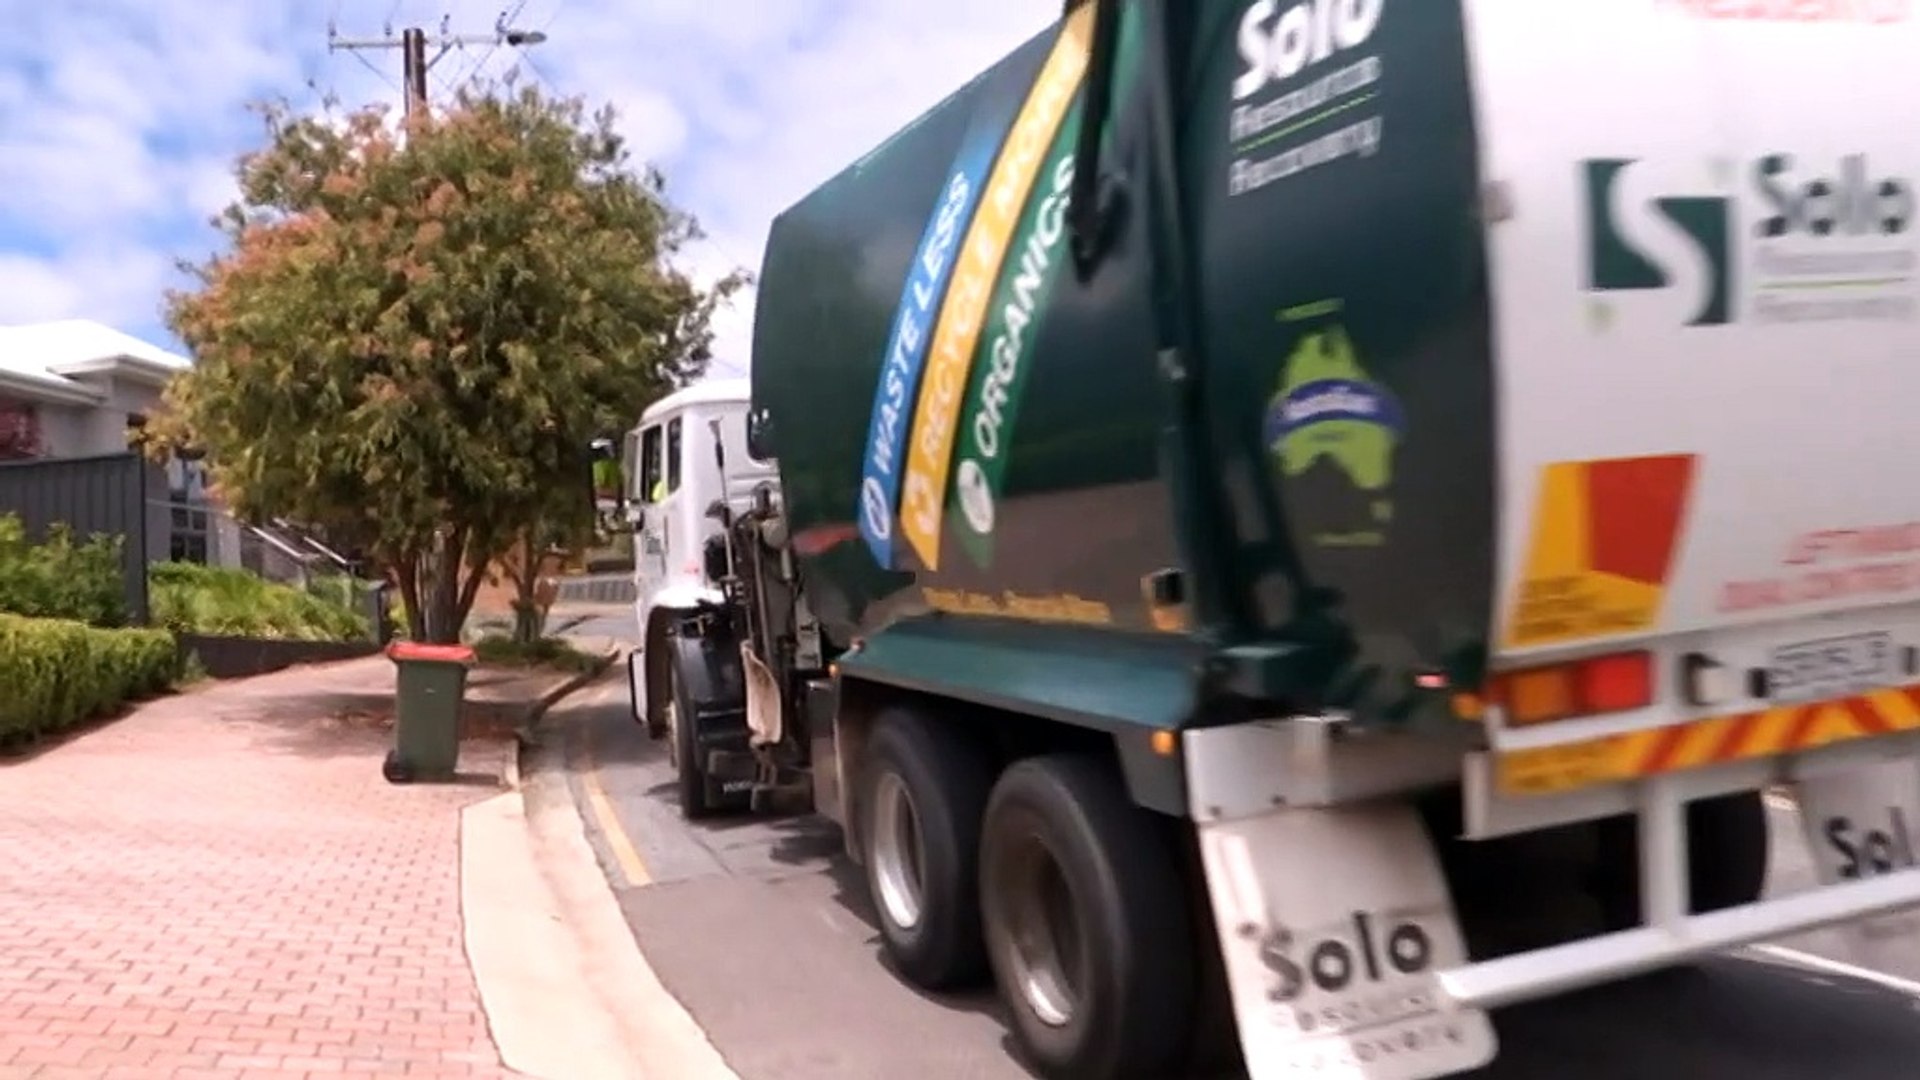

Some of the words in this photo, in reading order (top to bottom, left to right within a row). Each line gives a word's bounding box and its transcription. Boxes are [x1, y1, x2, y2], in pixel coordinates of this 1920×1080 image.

[1232, 0, 1384, 100] Solo
[1750, 152, 1917, 238] Solo
[873, 307, 920, 475] WASTE
[912, 170, 970, 311] LESS
[922, 220, 997, 472] RECYCLE
[974, 153, 1076, 458] ORGANICS
[1822, 806, 1914, 880] Sol
[1260, 909, 1432, 1002] Solo
